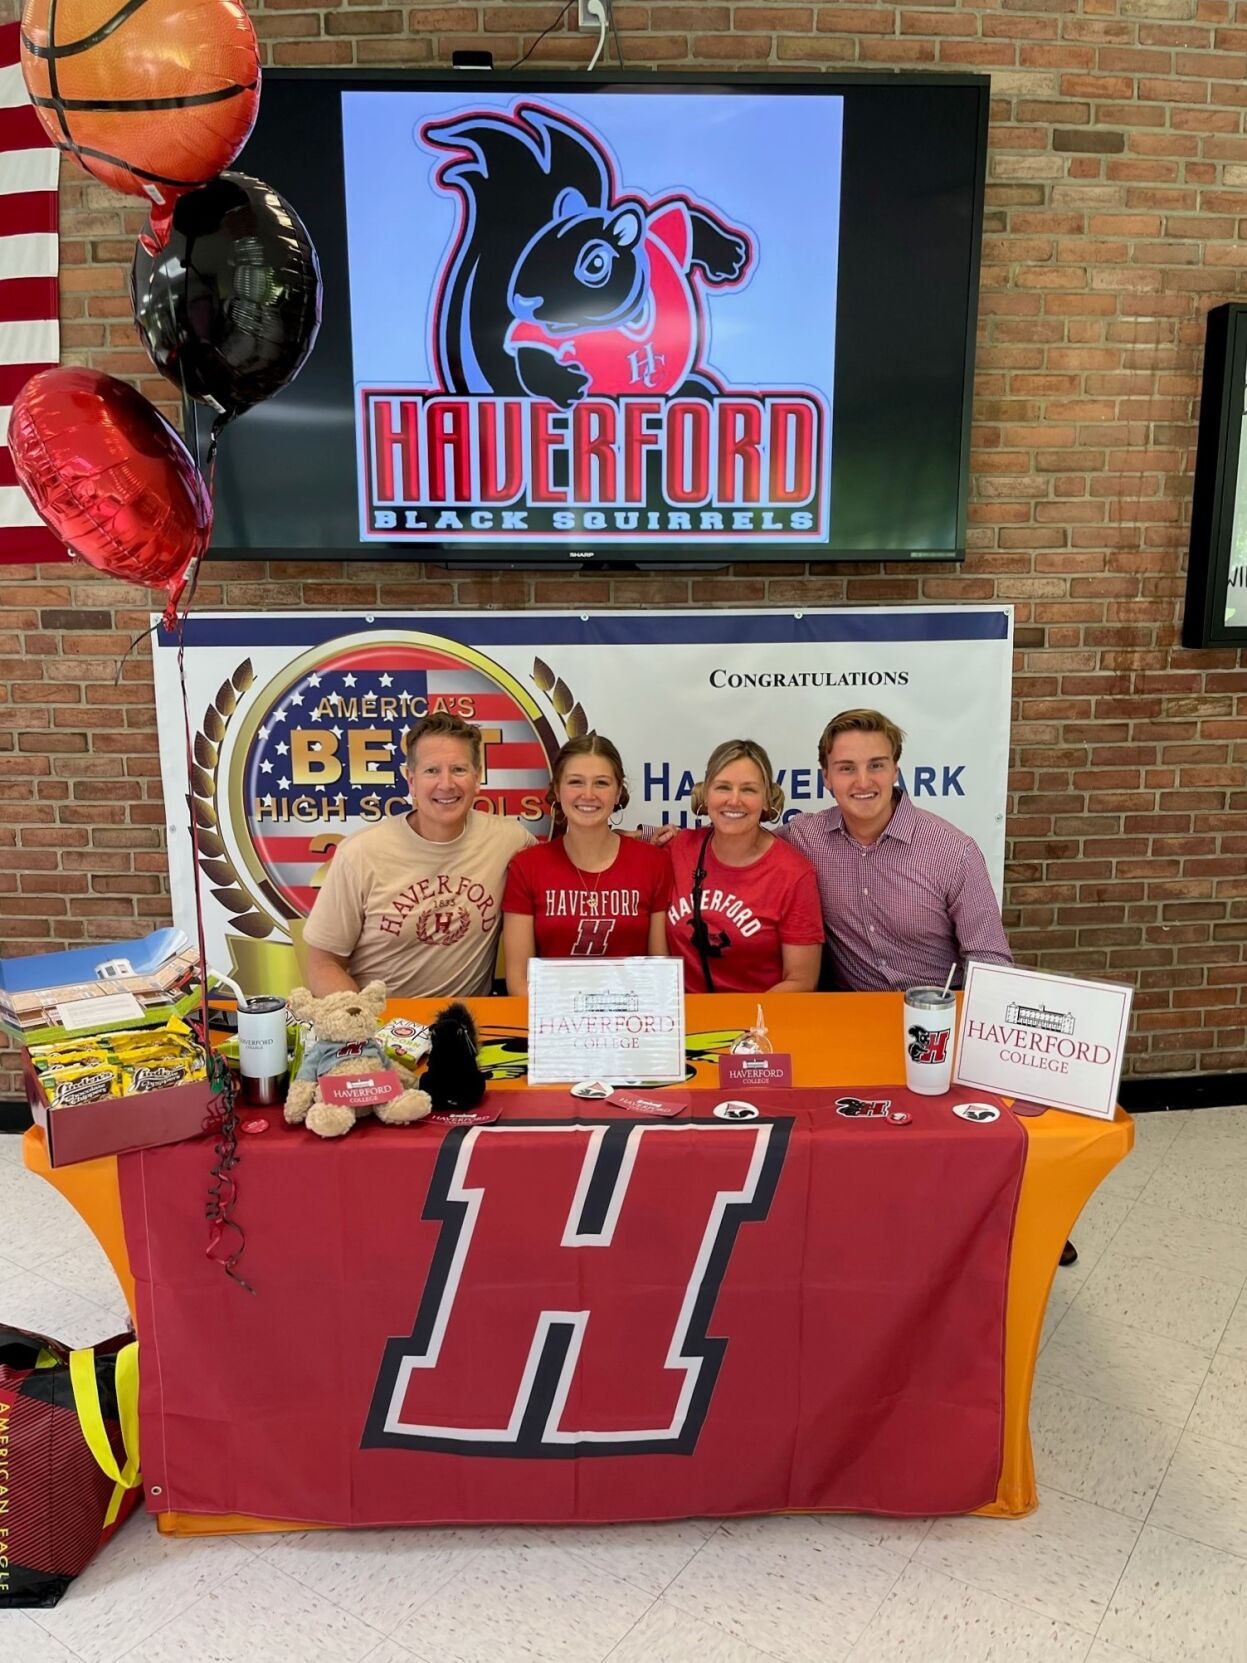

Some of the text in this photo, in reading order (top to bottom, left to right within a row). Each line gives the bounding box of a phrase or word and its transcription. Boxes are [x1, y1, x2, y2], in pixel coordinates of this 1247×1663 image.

[371, 397, 816, 506] HAVERFORD
[374, 510, 815, 530] BLACK SQUIRRELS
[1228, 566, 1247, 588] WI
[317, 696, 475, 719] AMERICA'S
[289, 728, 502, 785] BET
[254, 795, 545, 823] HIGH SCOLS
[380, 874, 497, 937] HAVERFORD
[545, 889, 640, 917] HAVERFORD
[667, 889, 762, 938] HAERFORD
[434, 911, 454, 934] H
[570, 918, 616, 956] H
[538, 1015, 675, 1034] HAVERFORD
[919, 1028, 951, 1064] H
[967, 1019, 1112, 1065] HAVERFORD
[729, 1068, 784, 1079] HAVERFORD
[999, 1048, 1069, 1075] COLLEGE
[333, 1084, 393, 1099] HAVERFORD
[349, 1095, 378, 1104] COLLEGE
[360, 1117, 796, 1458] H
[0, 1402, 11, 1514] AMERICAN
